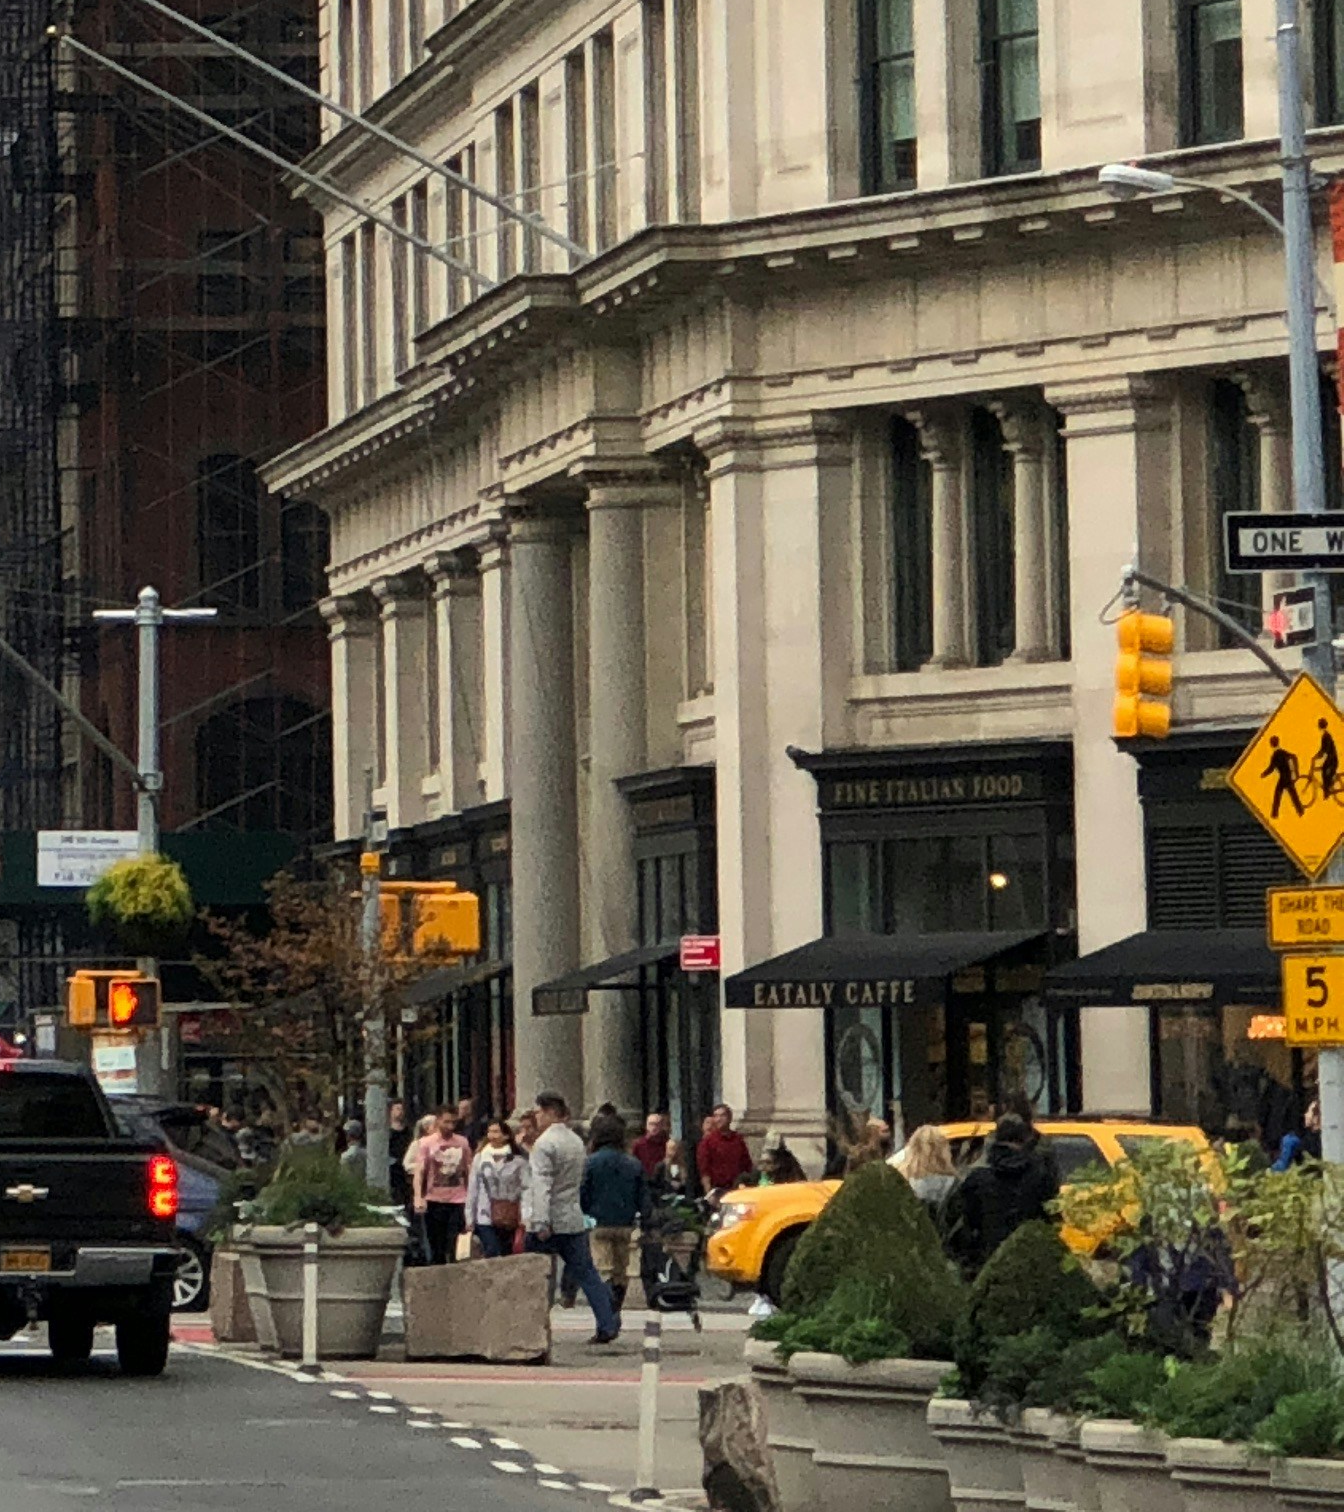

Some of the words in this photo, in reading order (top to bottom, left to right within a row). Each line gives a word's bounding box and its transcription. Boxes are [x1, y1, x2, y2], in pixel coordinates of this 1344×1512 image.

[1252, 530, 1303, 553] ONE
[835, 780, 880, 804] FINE
[886, 778, 965, 802] ITALIAN
[973, 775, 1022, 798] FOOD
[1297, 918, 1331, 935] ROAD
[754, 981, 836, 1006] EATALY
[1305, 966, 1329, 1008] 5
[1295, 1017, 1339, 1033] MPH
